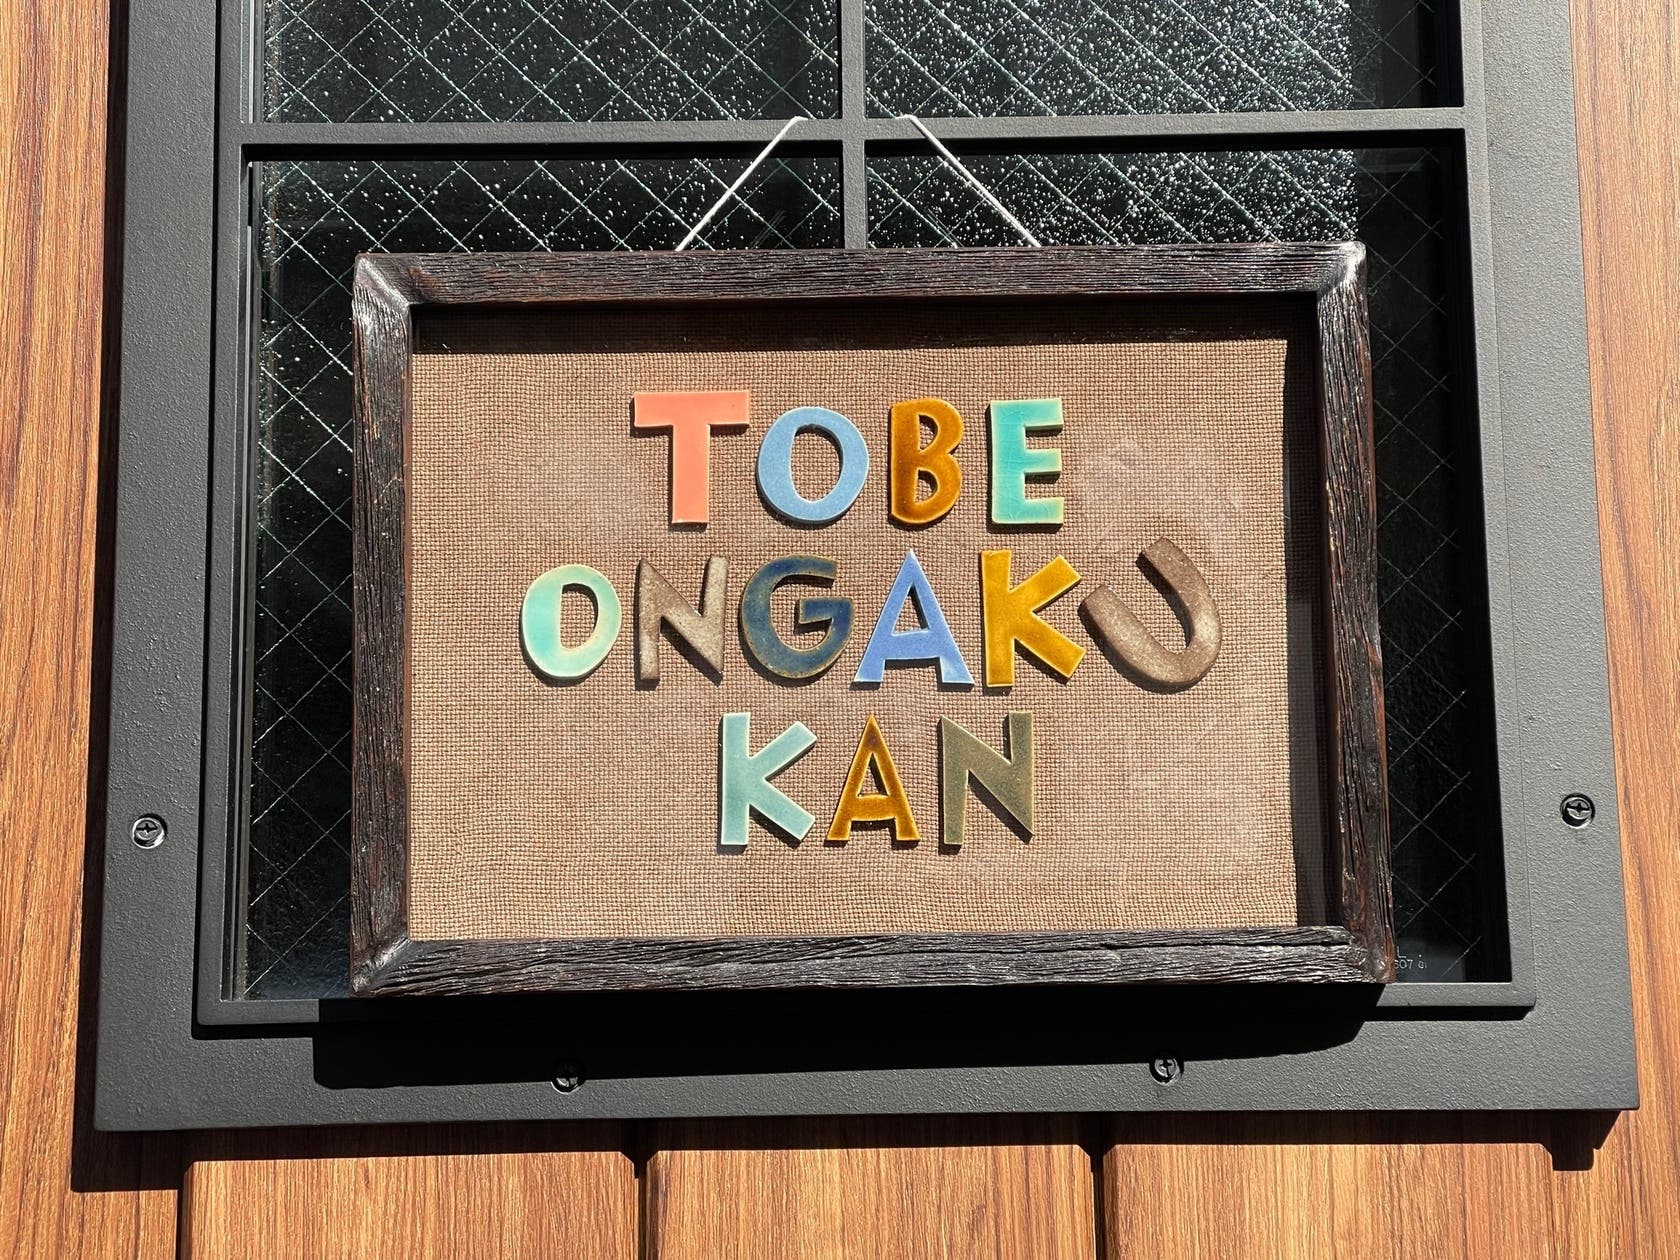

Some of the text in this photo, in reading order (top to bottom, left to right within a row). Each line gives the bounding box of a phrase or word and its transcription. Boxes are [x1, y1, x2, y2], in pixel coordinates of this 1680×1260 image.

[633, 391, 1064, 526] TOBE
[520, 537, 1222, 688] ONGAKU
[719, 711, 1035, 847] KAN
